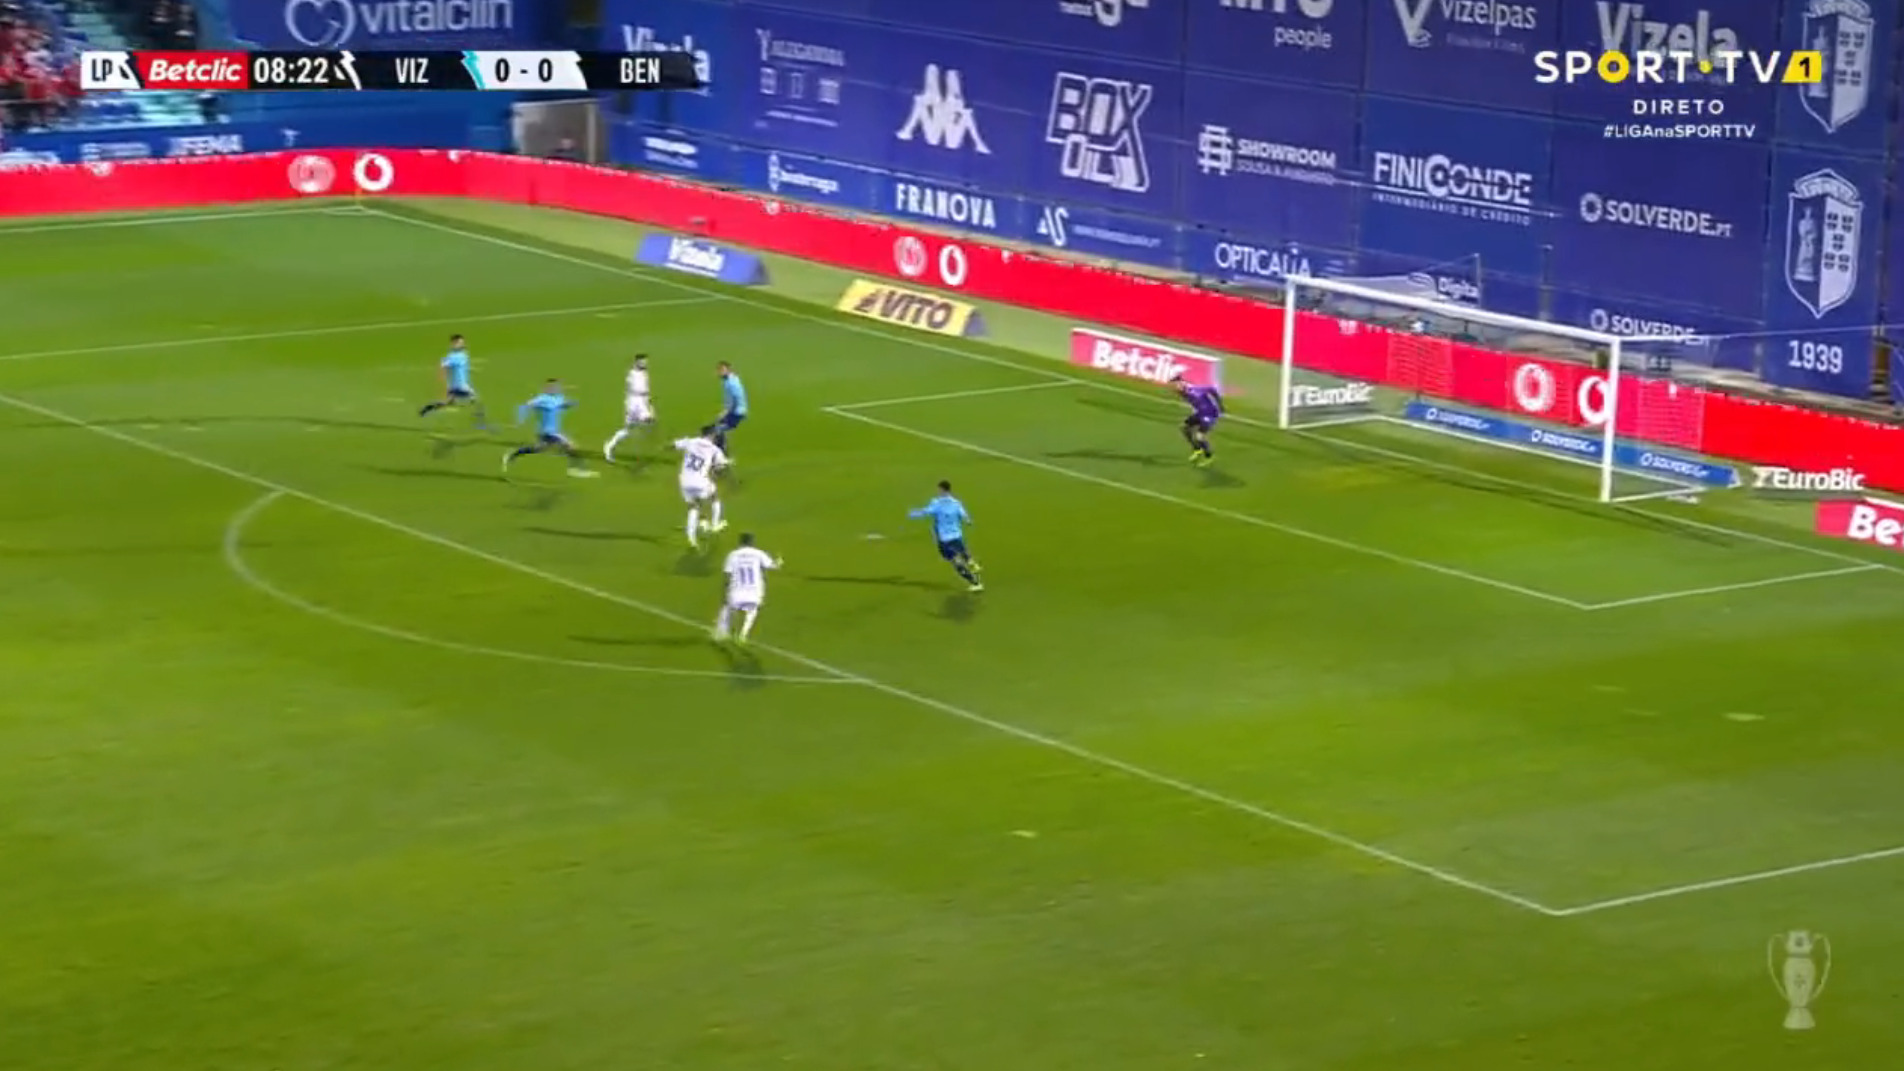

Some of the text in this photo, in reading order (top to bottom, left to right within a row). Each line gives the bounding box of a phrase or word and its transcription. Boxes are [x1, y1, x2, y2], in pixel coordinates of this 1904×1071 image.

[1274, 24, 1333, 49] people
[1046, 71, 1152, 193] BOX
[1237, 138, 1337, 169] SHOWROOM
[896, 184, 996, 229] FRANOVA
[880, 289, 953, 330] VITO
[1789, 340, 1844, 374] 1939
[1772, 467, 1867, 490] EuroBic
[1847, 504, 1904, 547] Be
[739, 566, 755, 585] 11
